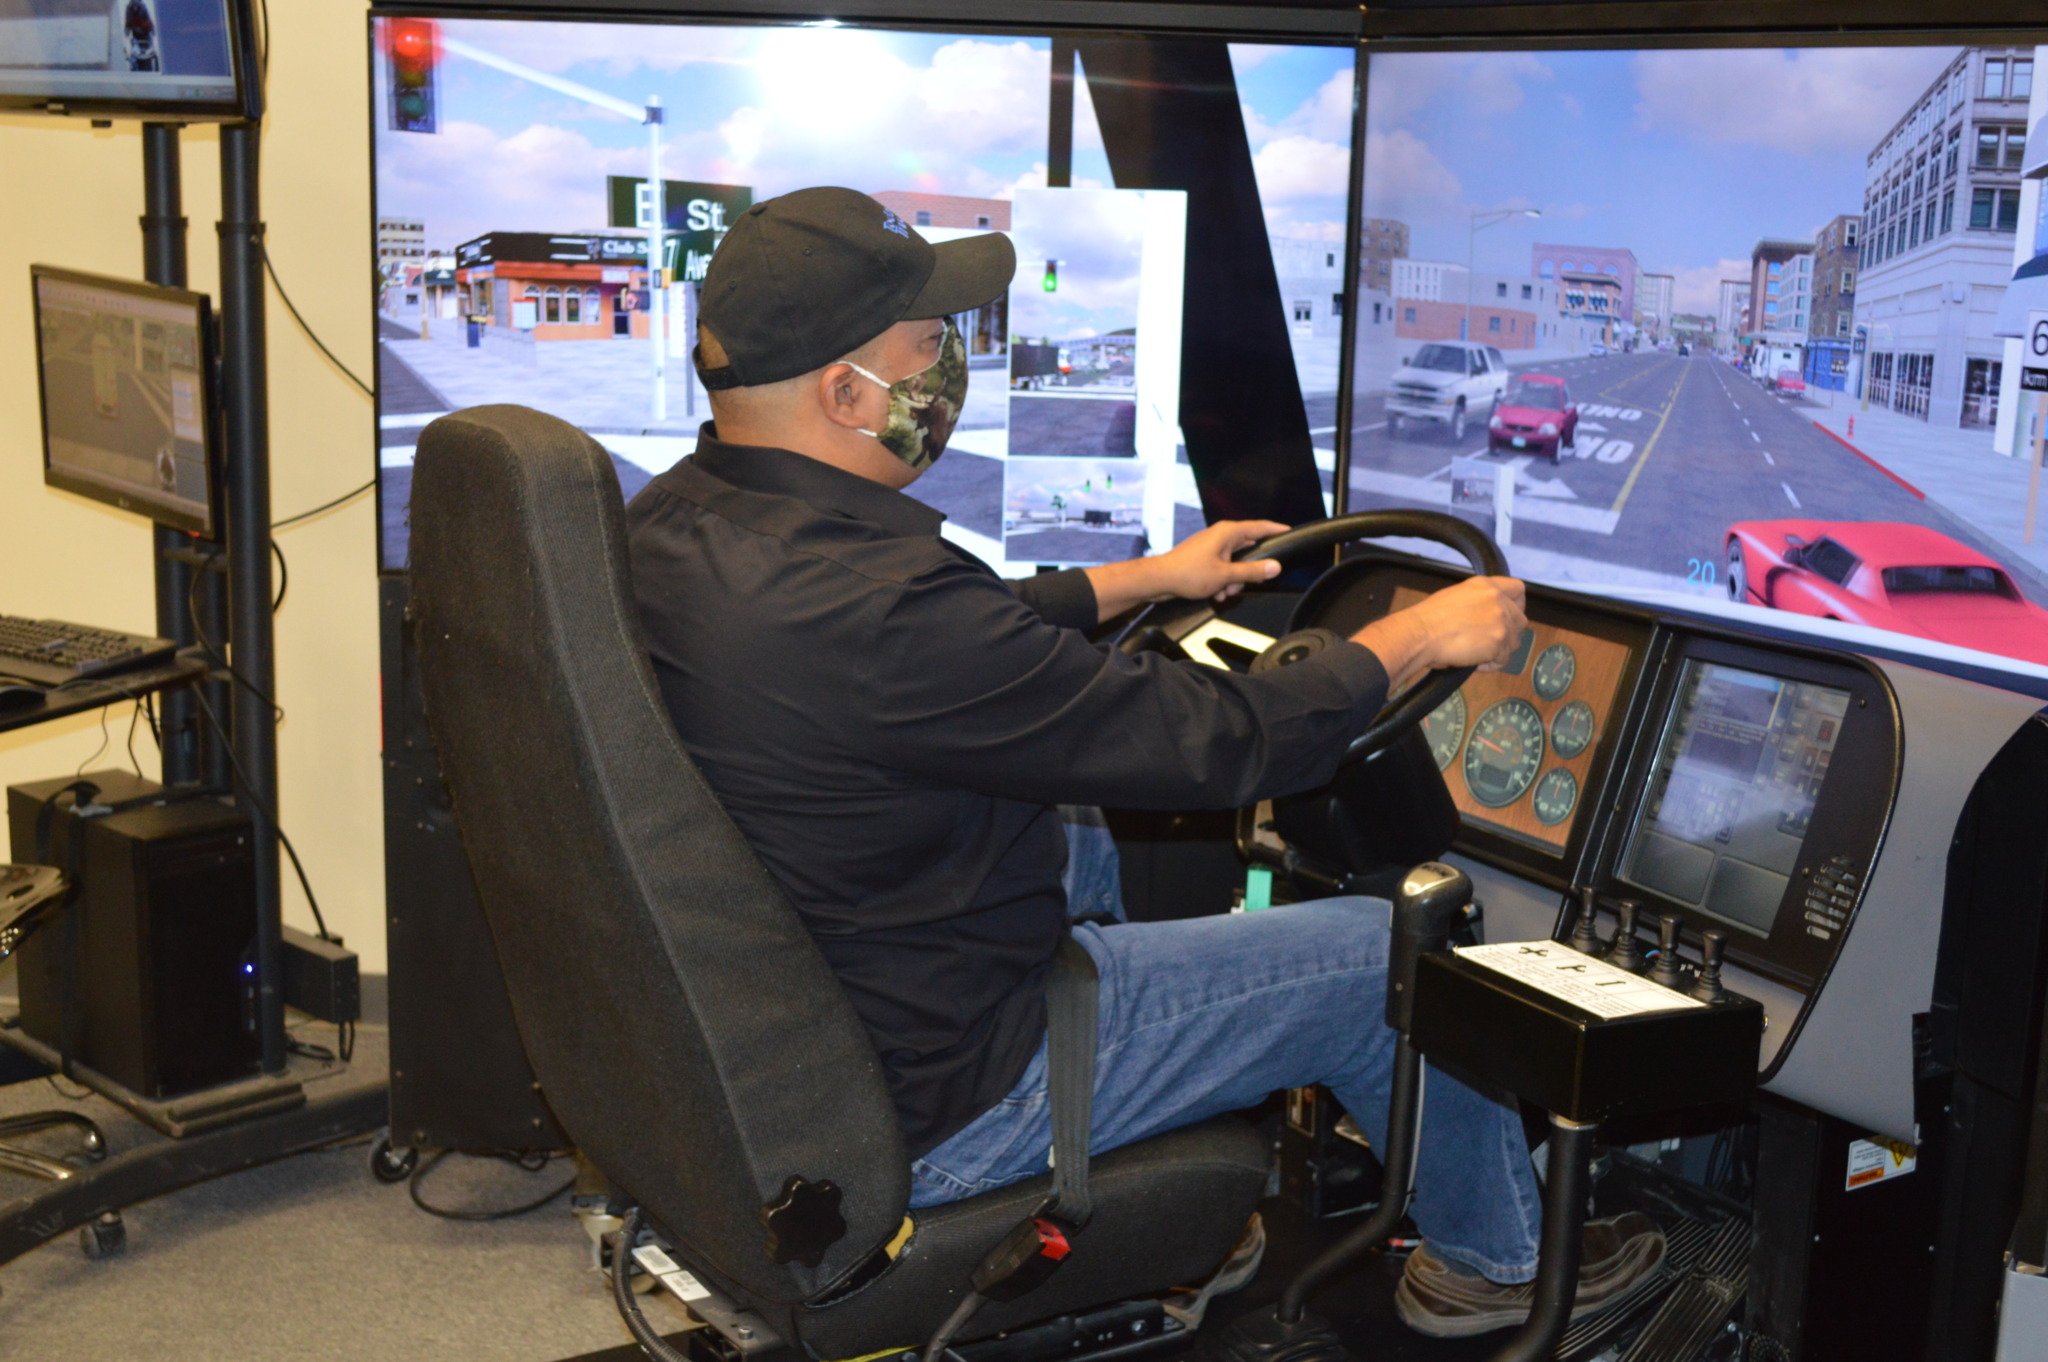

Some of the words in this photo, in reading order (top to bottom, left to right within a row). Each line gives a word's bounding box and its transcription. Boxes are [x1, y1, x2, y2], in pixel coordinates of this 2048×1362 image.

[686, 198, 730, 232] St.
[602, 240, 635, 254] Club
[1687, 557, 1716, 590] 20
